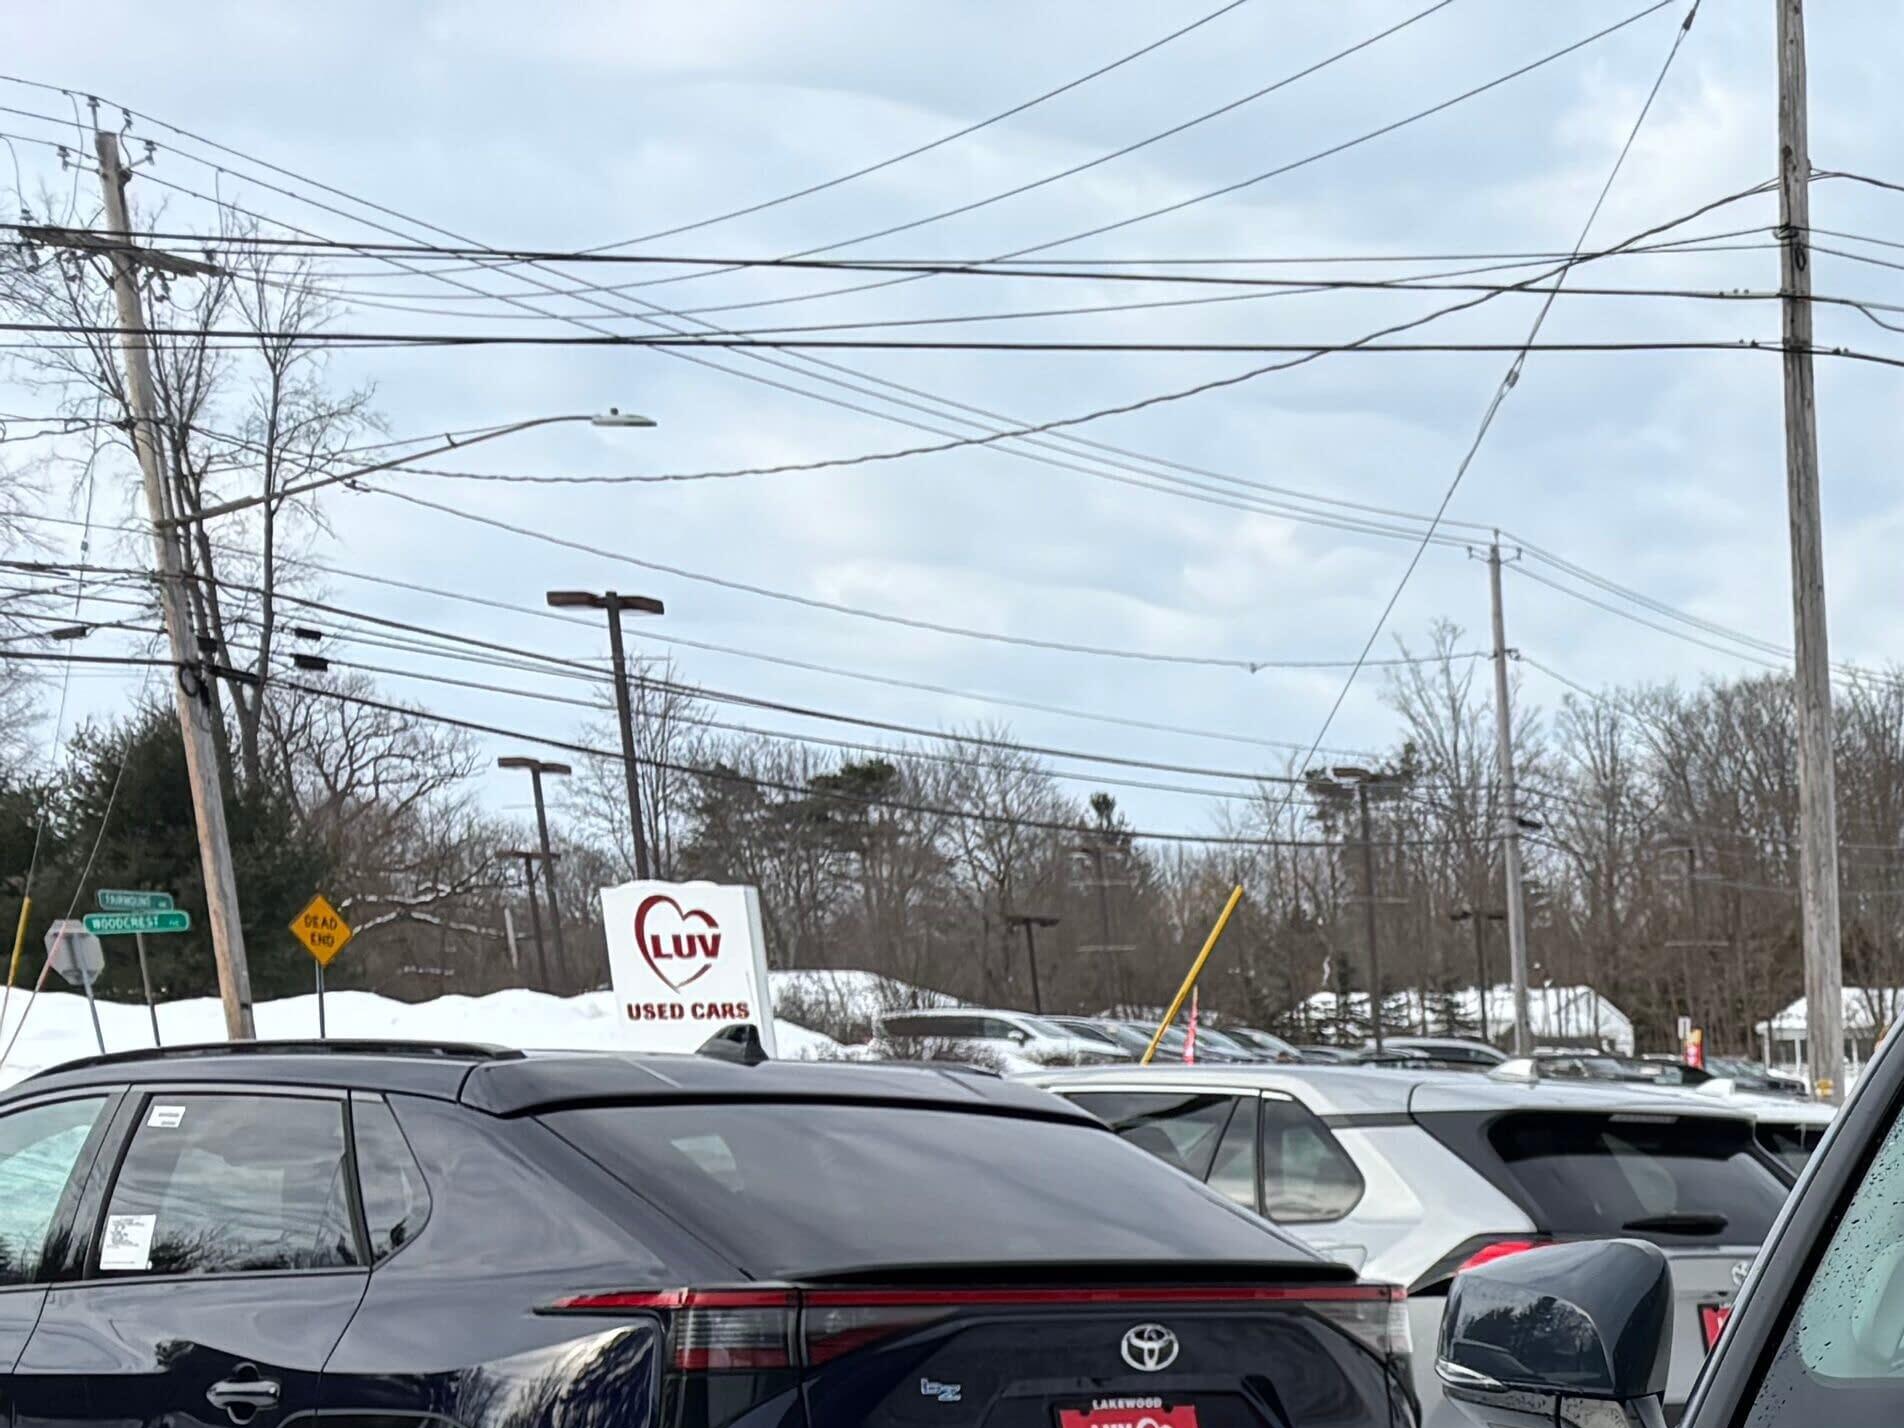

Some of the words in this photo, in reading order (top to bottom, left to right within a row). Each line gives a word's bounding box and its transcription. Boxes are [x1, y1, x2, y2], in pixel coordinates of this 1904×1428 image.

[92, 915, 159, 930] WOODCREST
[304, 914, 338, 931] DEAD
[310, 932, 335, 948] END
[650, 933, 721, 960] LUV
[627, 1002, 685, 1021] USED
[690, 1002, 751, 1021] CARS
[1092, 1397, 1163, 1411] LAKEWOOD
